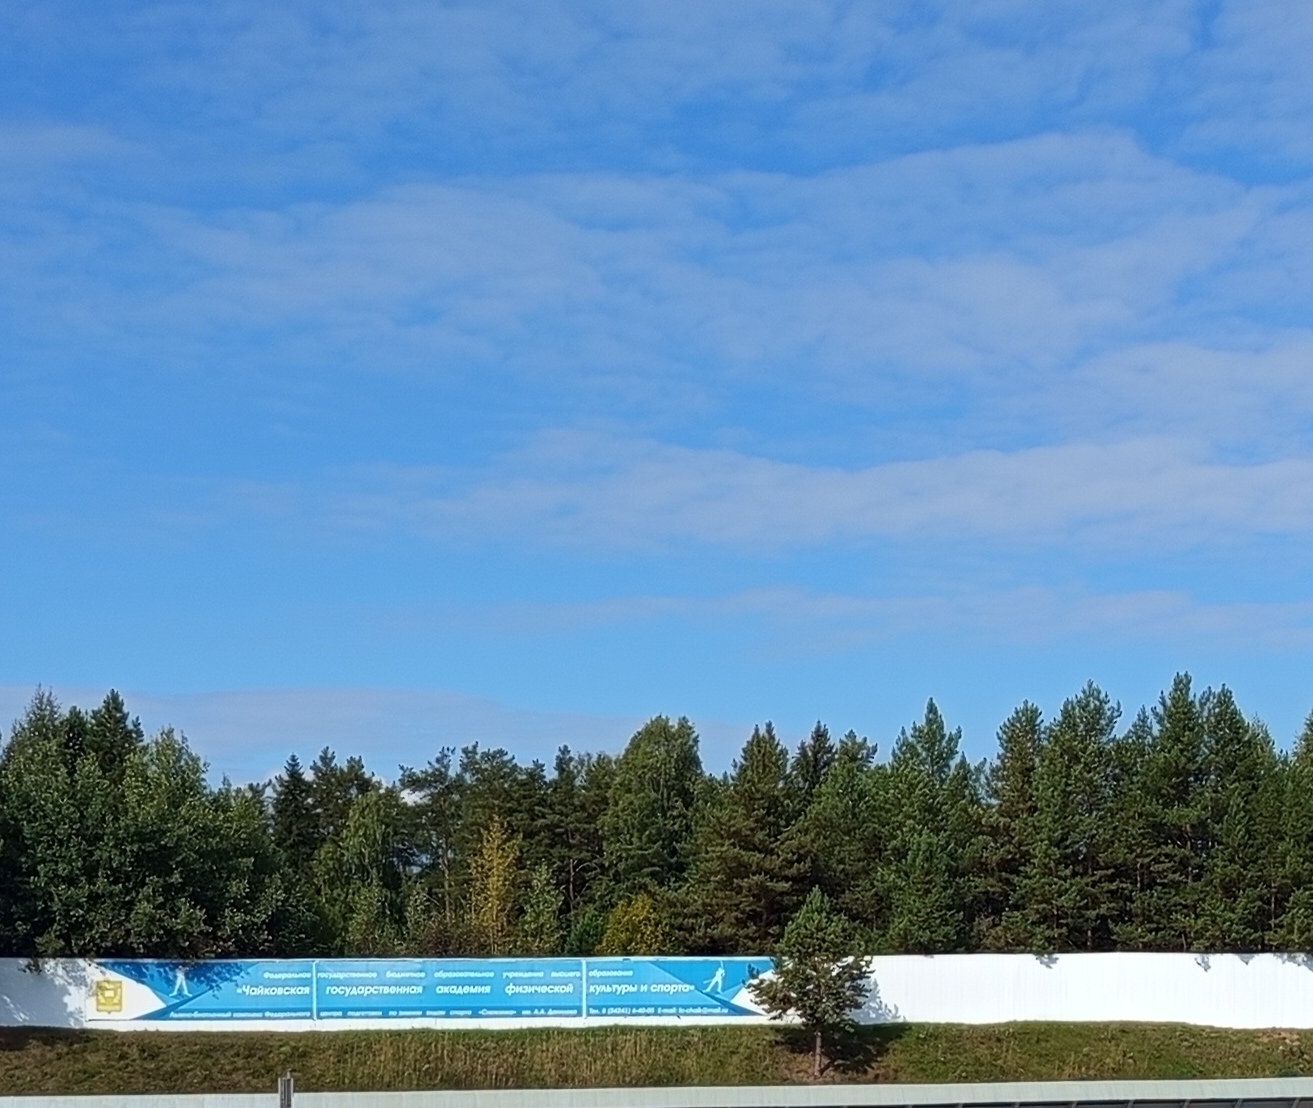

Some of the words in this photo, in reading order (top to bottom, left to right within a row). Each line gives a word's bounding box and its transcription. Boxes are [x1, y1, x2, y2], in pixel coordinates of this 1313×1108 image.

[326, 985, 423, 997] государственная
[436, 984, 491, 995] академия
[505, 982, 573, 996] физической
[589, 984, 637, 995] культуры
[640, 984, 647, 992] и
